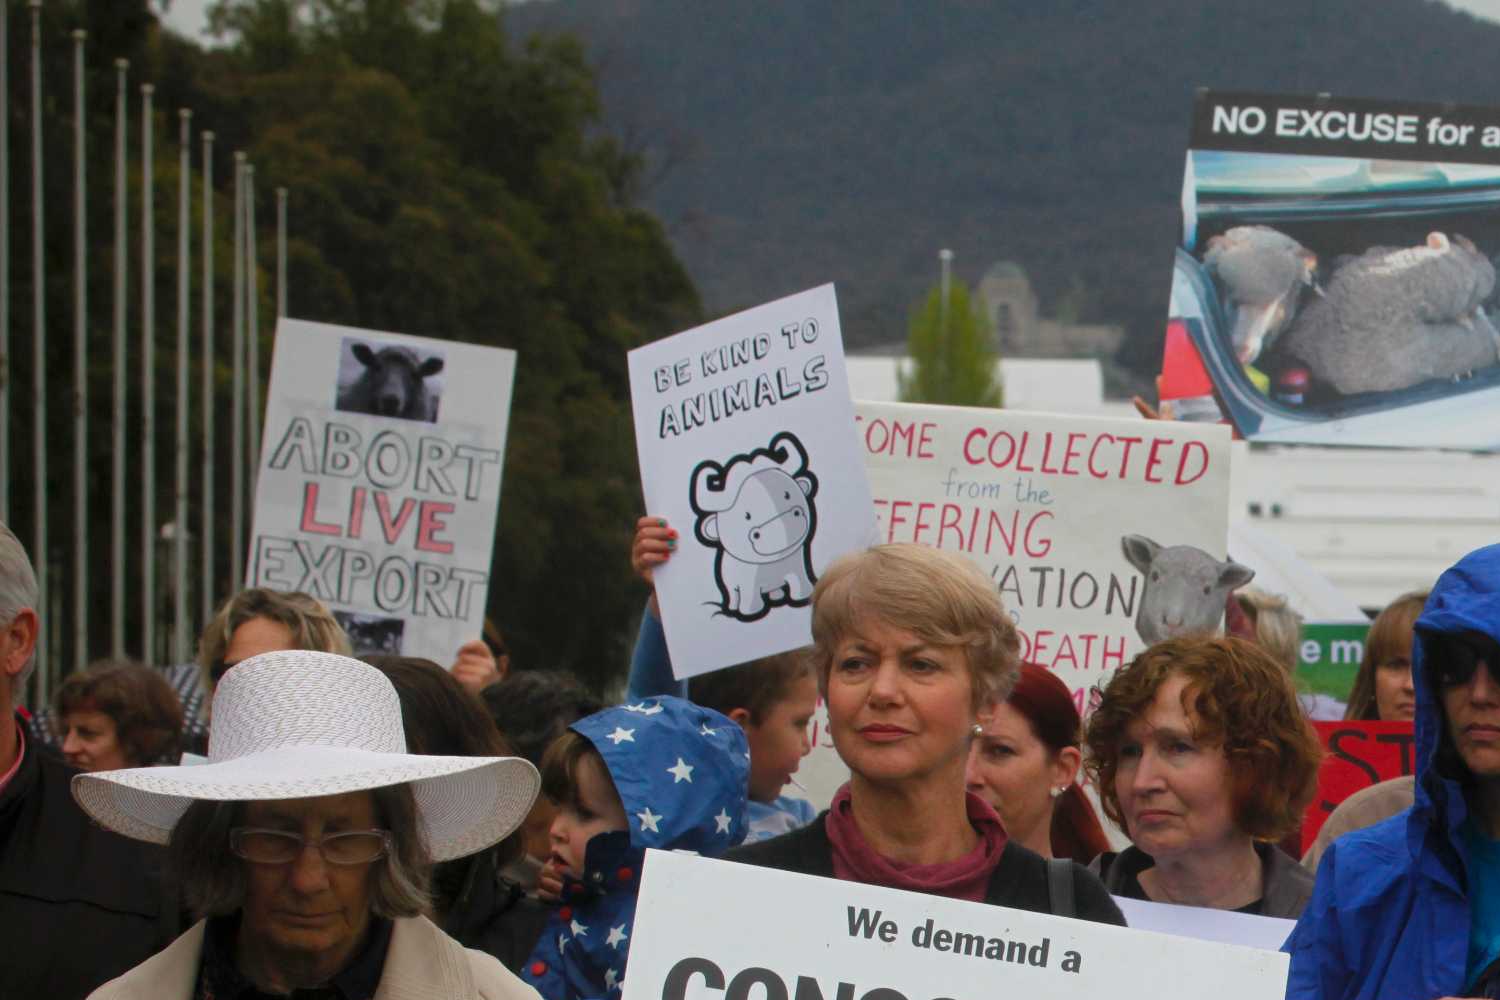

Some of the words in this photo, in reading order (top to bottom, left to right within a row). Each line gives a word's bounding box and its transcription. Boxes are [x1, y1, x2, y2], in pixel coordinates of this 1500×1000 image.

[1212, 105, 1266, 135] NO
[1275, 108, 1419, 143] EXCUSE
[1426, 117, 1474, 145] for
[654, 357, 692, 394] BE
[700, 332, 772, 378] KIND
[781, 317, 819, 350] TO
[659, 354, 830, 439] ANIMALS
[268, 416, 501, 502] ABORT
[845, 412, 938, 460] OME
[963, 427, 1210, 486] COLLECTED
[300, 482, 456, 556] LIVE
[942, 468, 1001, 499] from
[1015, 477, 1055, 505] the
[873, 499, 1055, 559] FERING
[254, 535, 489, 621] EXPORT
[991, 564, 1137, 618] ATION
[847, 905, 898, 943] We
[911, 918, 1050, 968] demand
[1060, 950, 1081, 974] a
